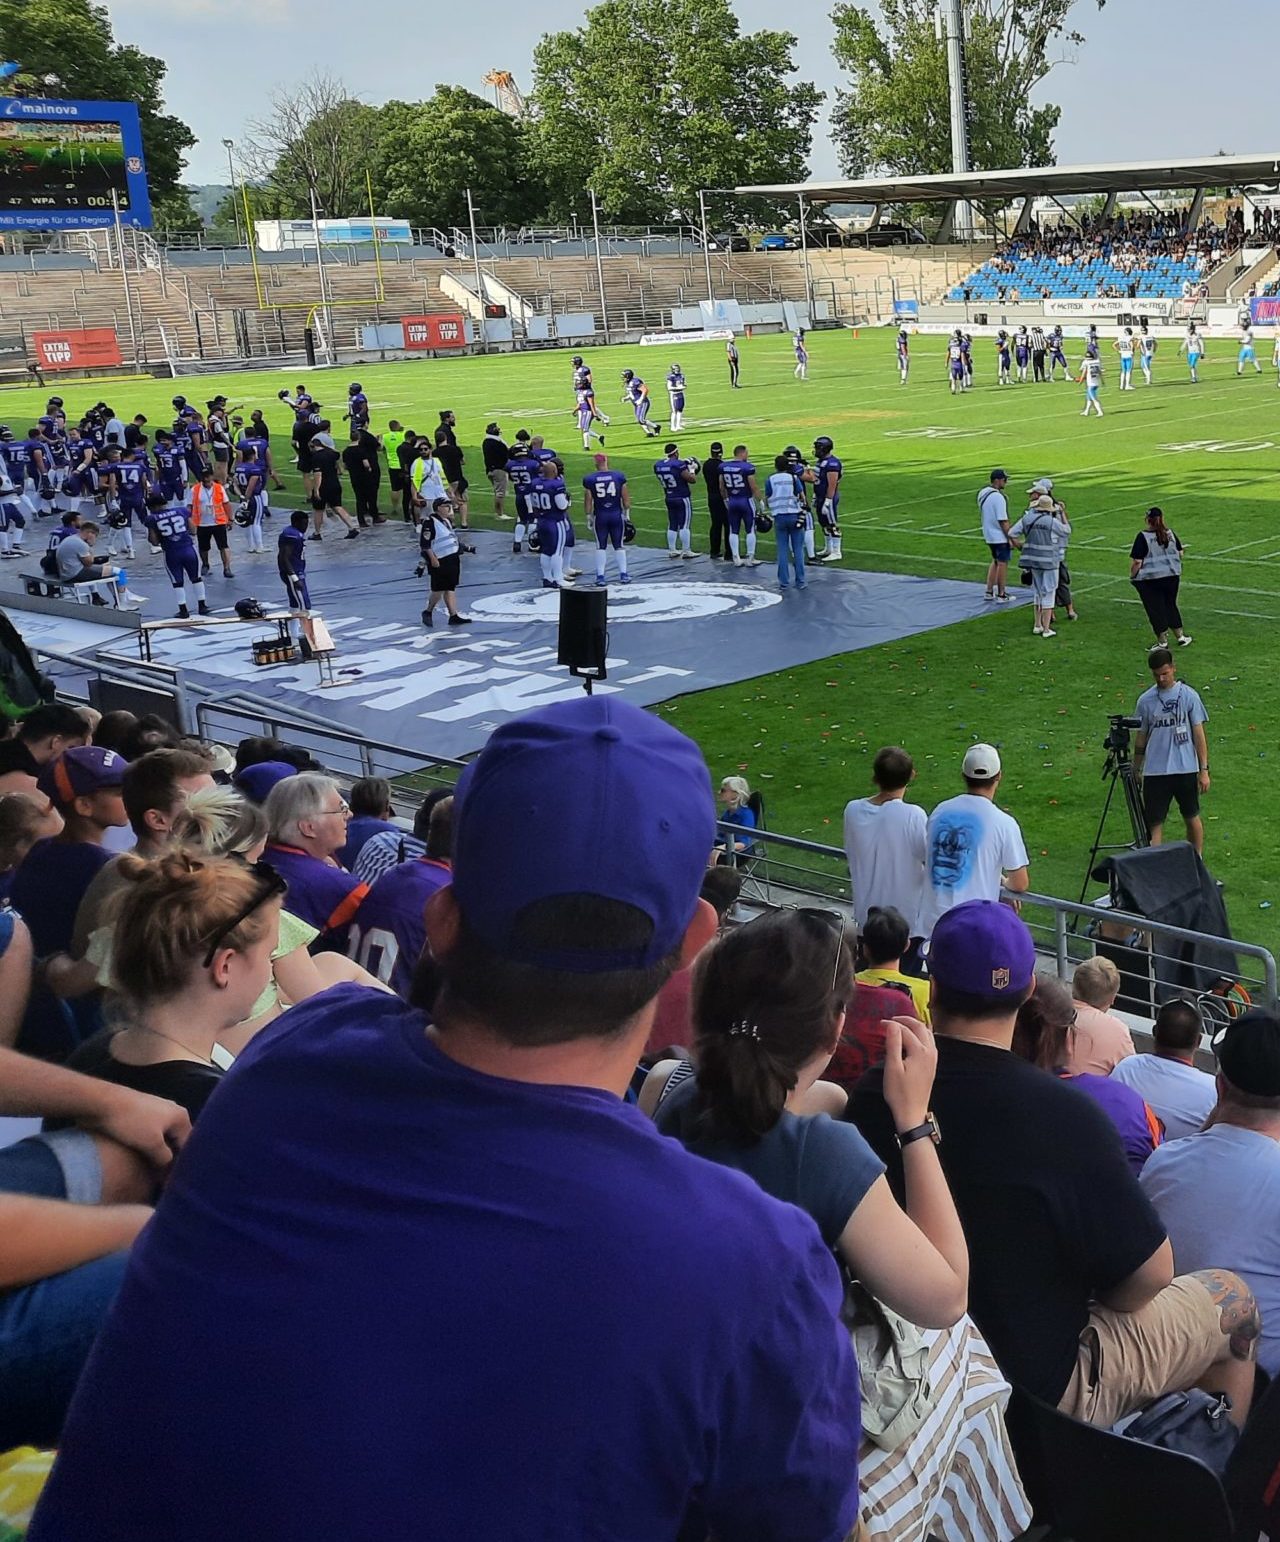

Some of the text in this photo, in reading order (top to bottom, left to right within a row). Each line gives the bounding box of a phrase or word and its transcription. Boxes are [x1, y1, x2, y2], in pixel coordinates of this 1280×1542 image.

[22, 104, 78, 115] mainova
[31, 197, 56, 205] WPA
[17, 217, 49, 226] Energie
[66, 216, 79, 225] die
[81, 216, 110, 226] Region
[408, 332, 428, 342] TIPP
[439, 331, 458, 340] TIPP
[42, 342, 70, 352] EXTRA
[44, 351, 72, 363] TIPP
[120, 469, 140, 483] 14
[722, 473, 746, 488] 92
[595, 481, 617, 498] 54
[156, 515, 187, 537] 52
